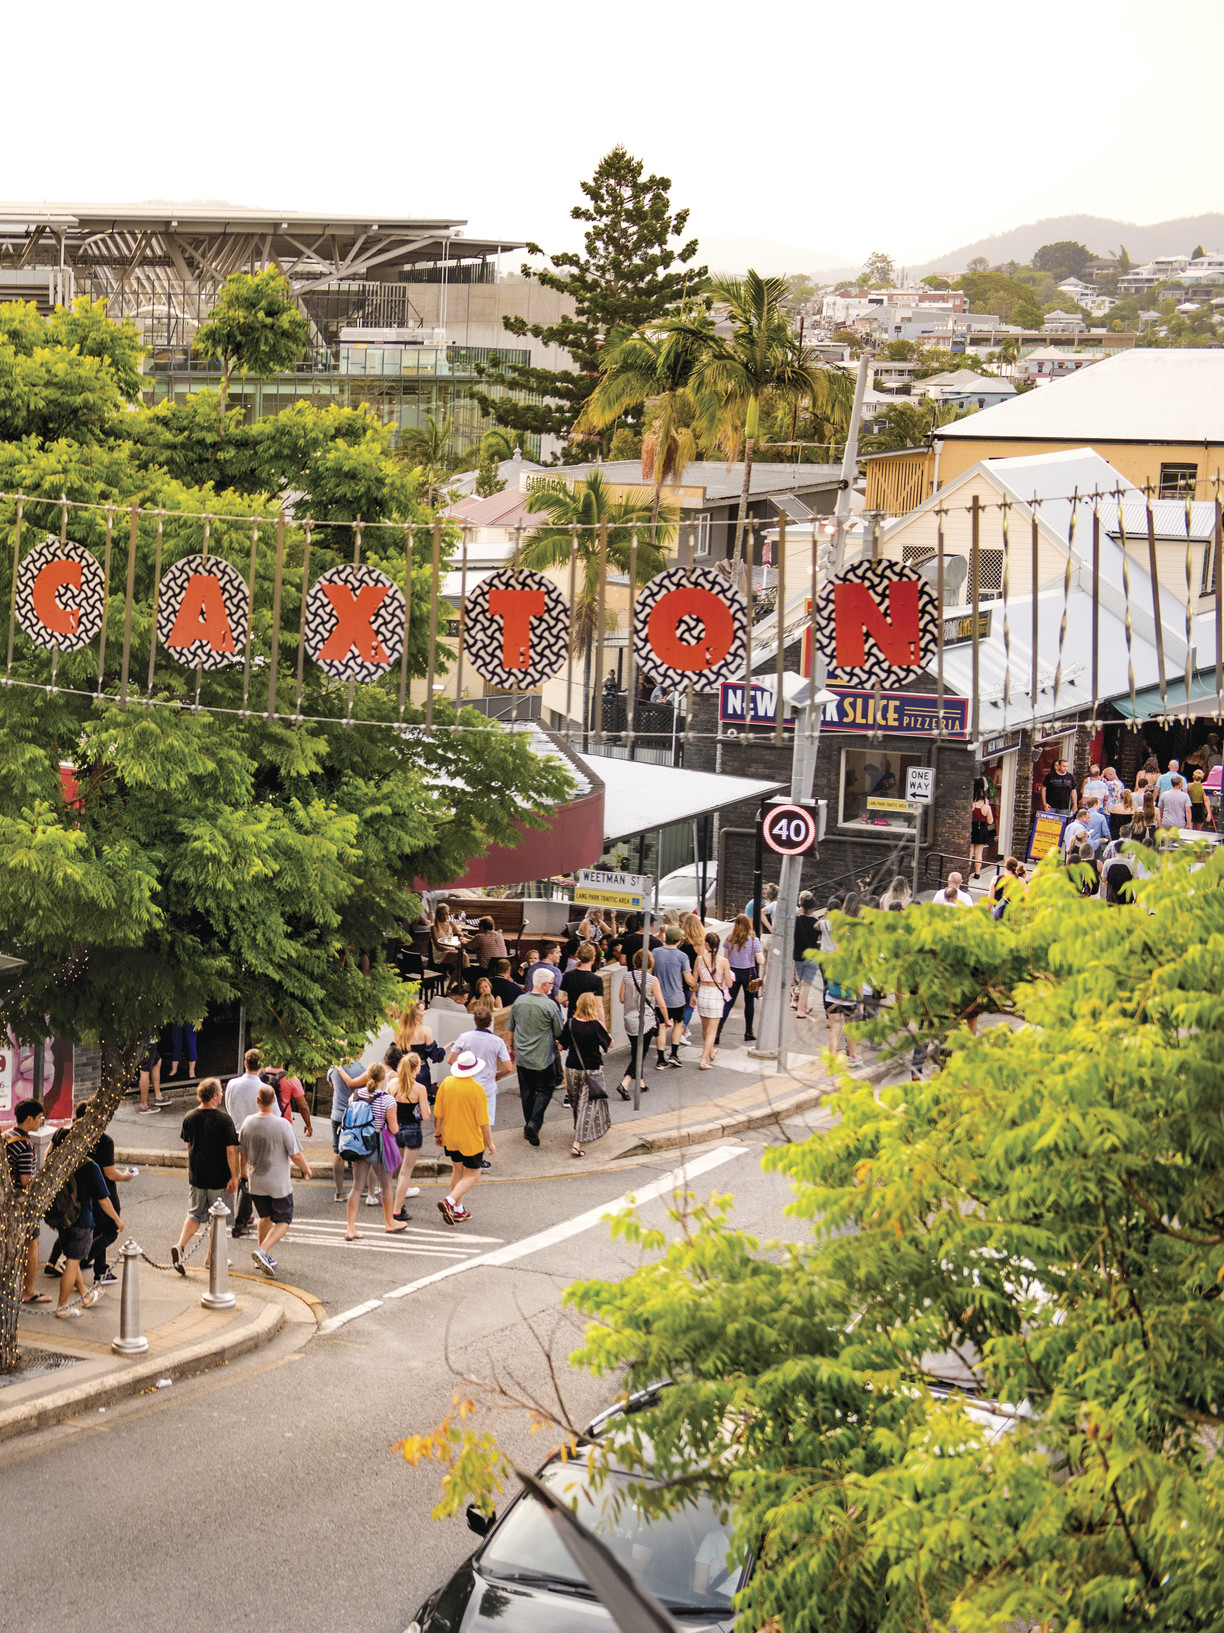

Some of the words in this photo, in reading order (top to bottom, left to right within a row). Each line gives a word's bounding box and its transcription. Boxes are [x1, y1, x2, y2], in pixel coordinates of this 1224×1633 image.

[33, 559, 921, 671] CAXTON
[727, 688, 777, 717] NEW
[842, 697, 900, 727] SLICE
[903, 715, 961, 731] PIZZERIA
[911, 770, 929, 780] ONE
[909, 781, 930, 790] WAY
[772, 818, 806, 842] 40
[583, 872, 626, 885] WEETMAN
[630, 876, 640, 887] ST
[576, 892, 587, 900] LANG
[600, 895, 618, 903] TRAFFIC
[0, 1081, 5, 1089] 6
